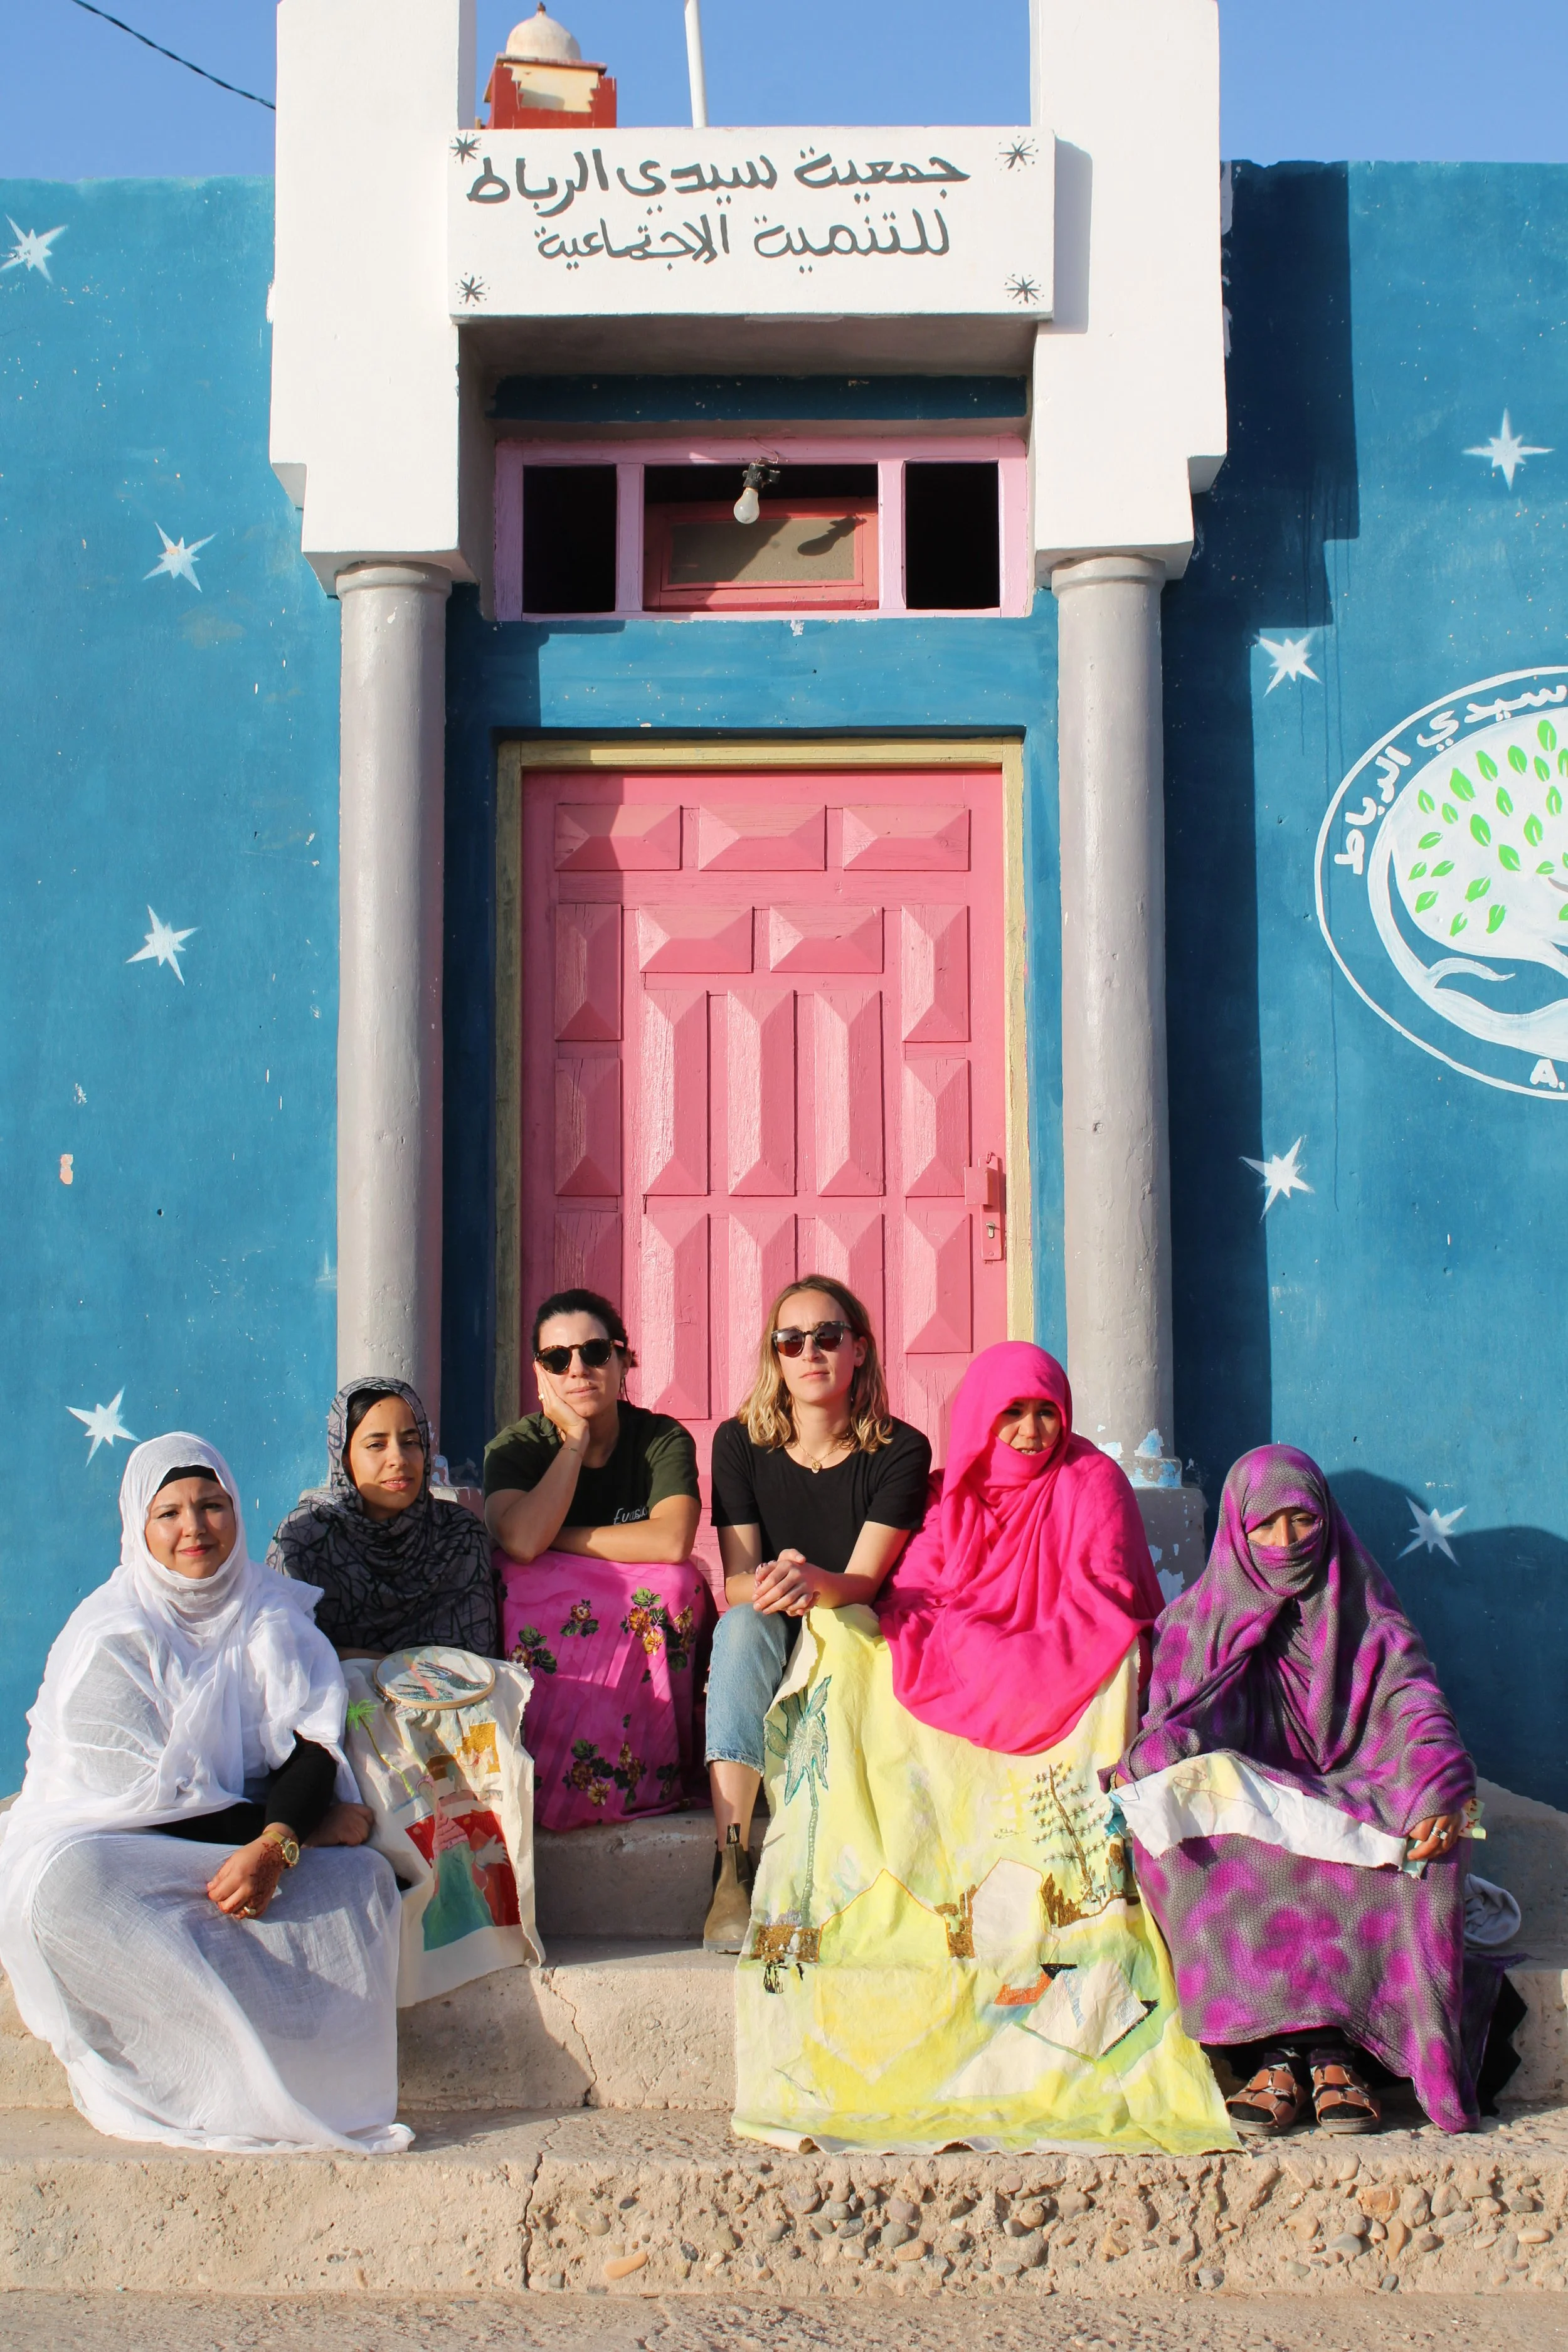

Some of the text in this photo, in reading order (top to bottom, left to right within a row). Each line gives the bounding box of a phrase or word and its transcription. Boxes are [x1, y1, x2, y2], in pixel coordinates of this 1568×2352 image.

[466, 146, 971, 218] جمعية سيدي الرباط
[753, 208, 950, 274] للتنمية
[1333, 685, 1567, 876] سيدي الرباط
